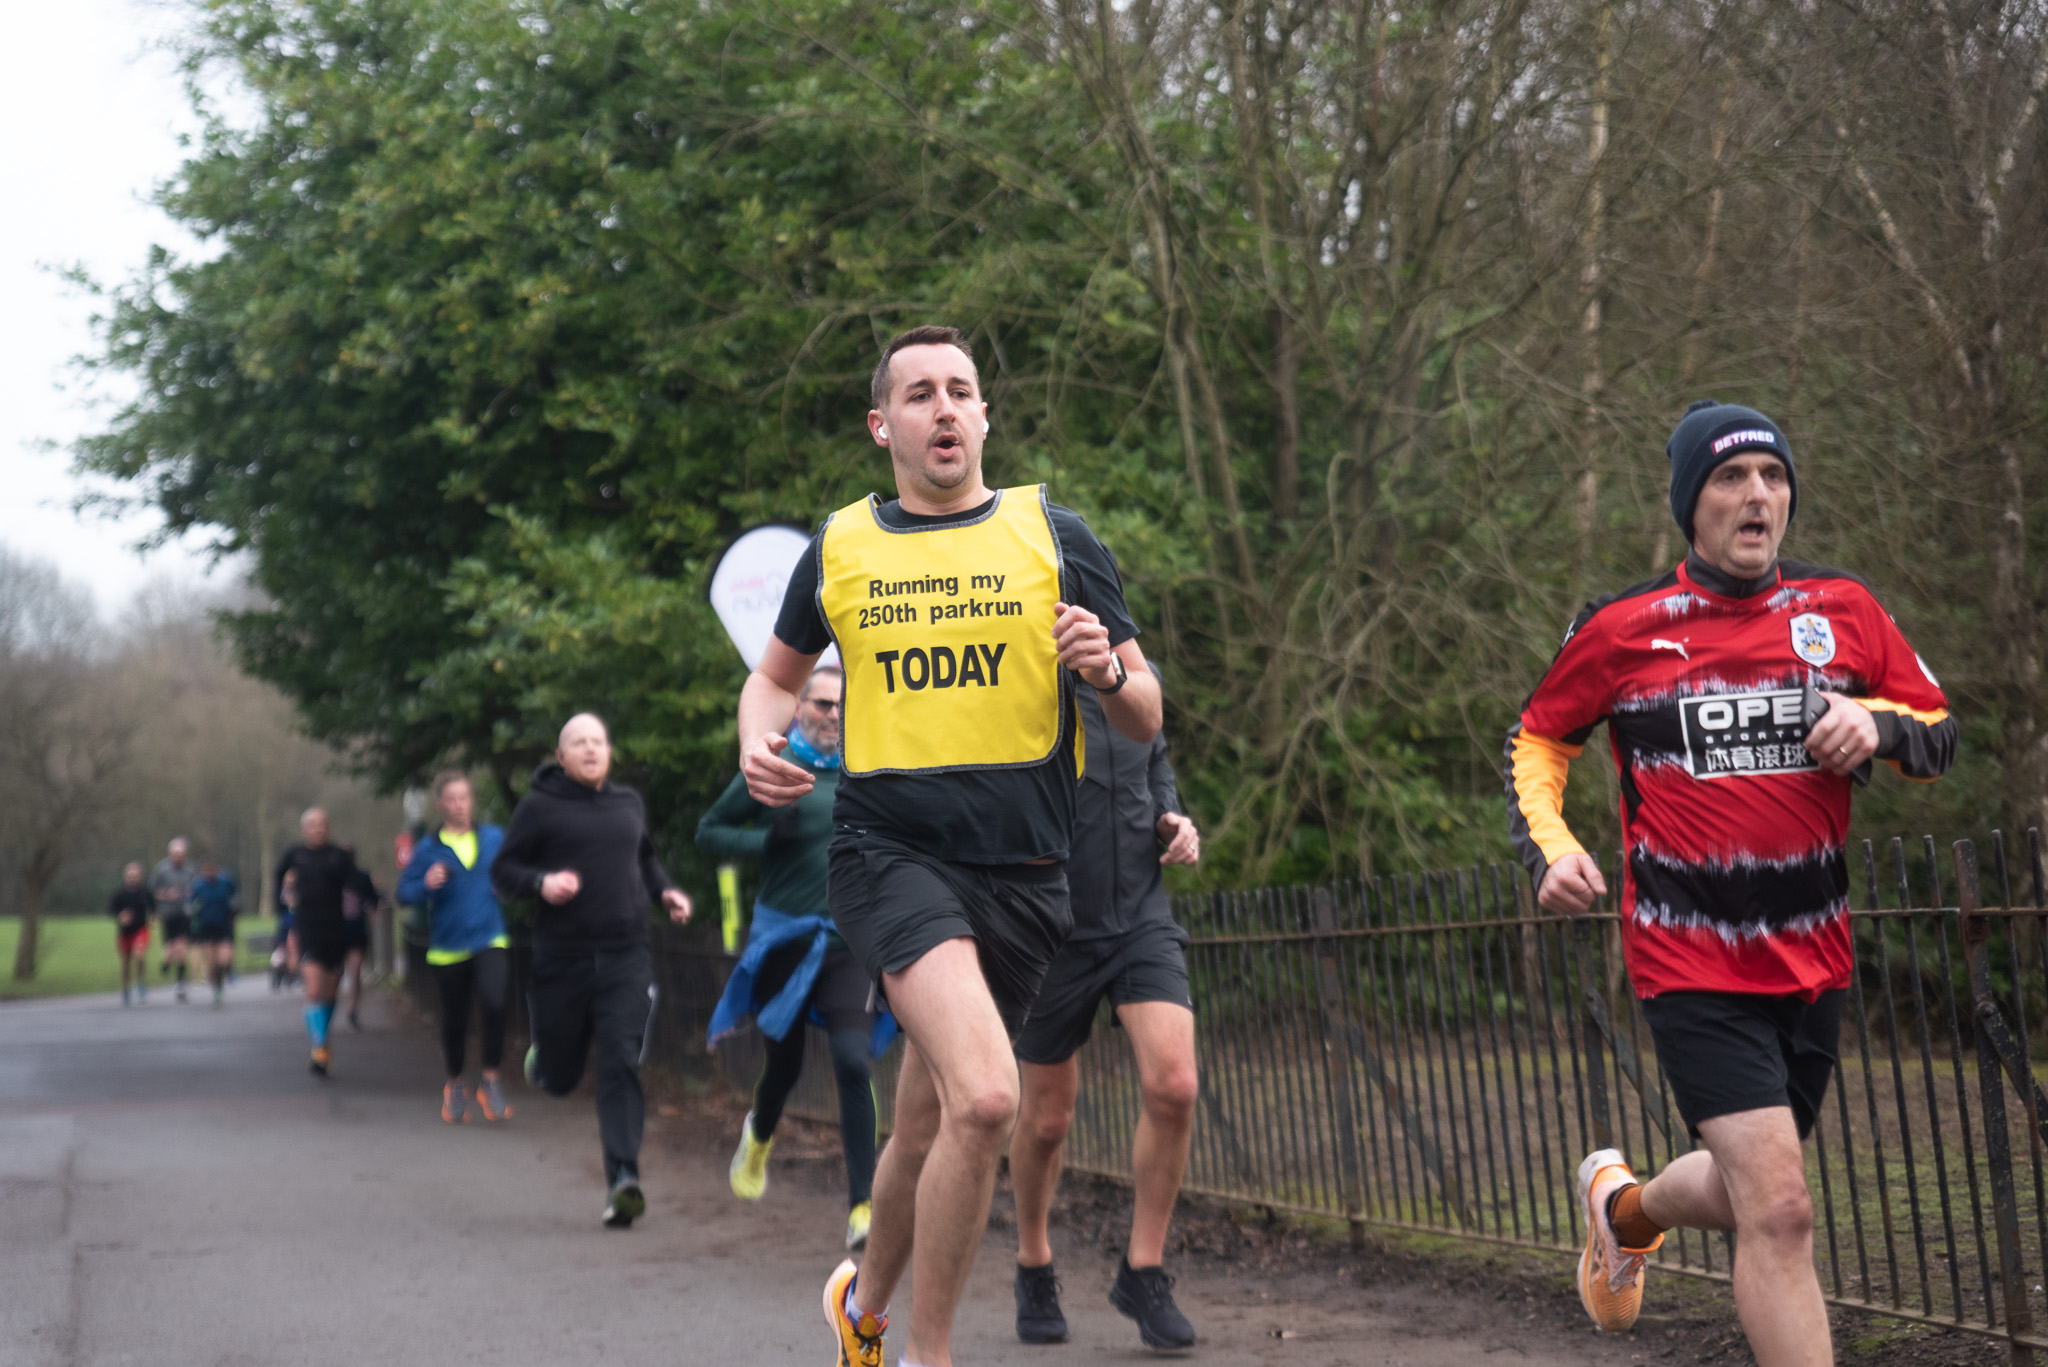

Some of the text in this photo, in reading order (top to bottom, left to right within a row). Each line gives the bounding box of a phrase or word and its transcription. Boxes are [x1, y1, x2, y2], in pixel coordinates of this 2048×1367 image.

[1714, 430, 1775, 454] BETFRED
[869, 574, 1006, 599] Running my
[858, 598, 1022, 629] 250th parkrun
[875, 643, 1007, 693] TODAY
[1697, 695, 1803, 731] OPE
[1705, 729, 1803, 744] SPORTS
